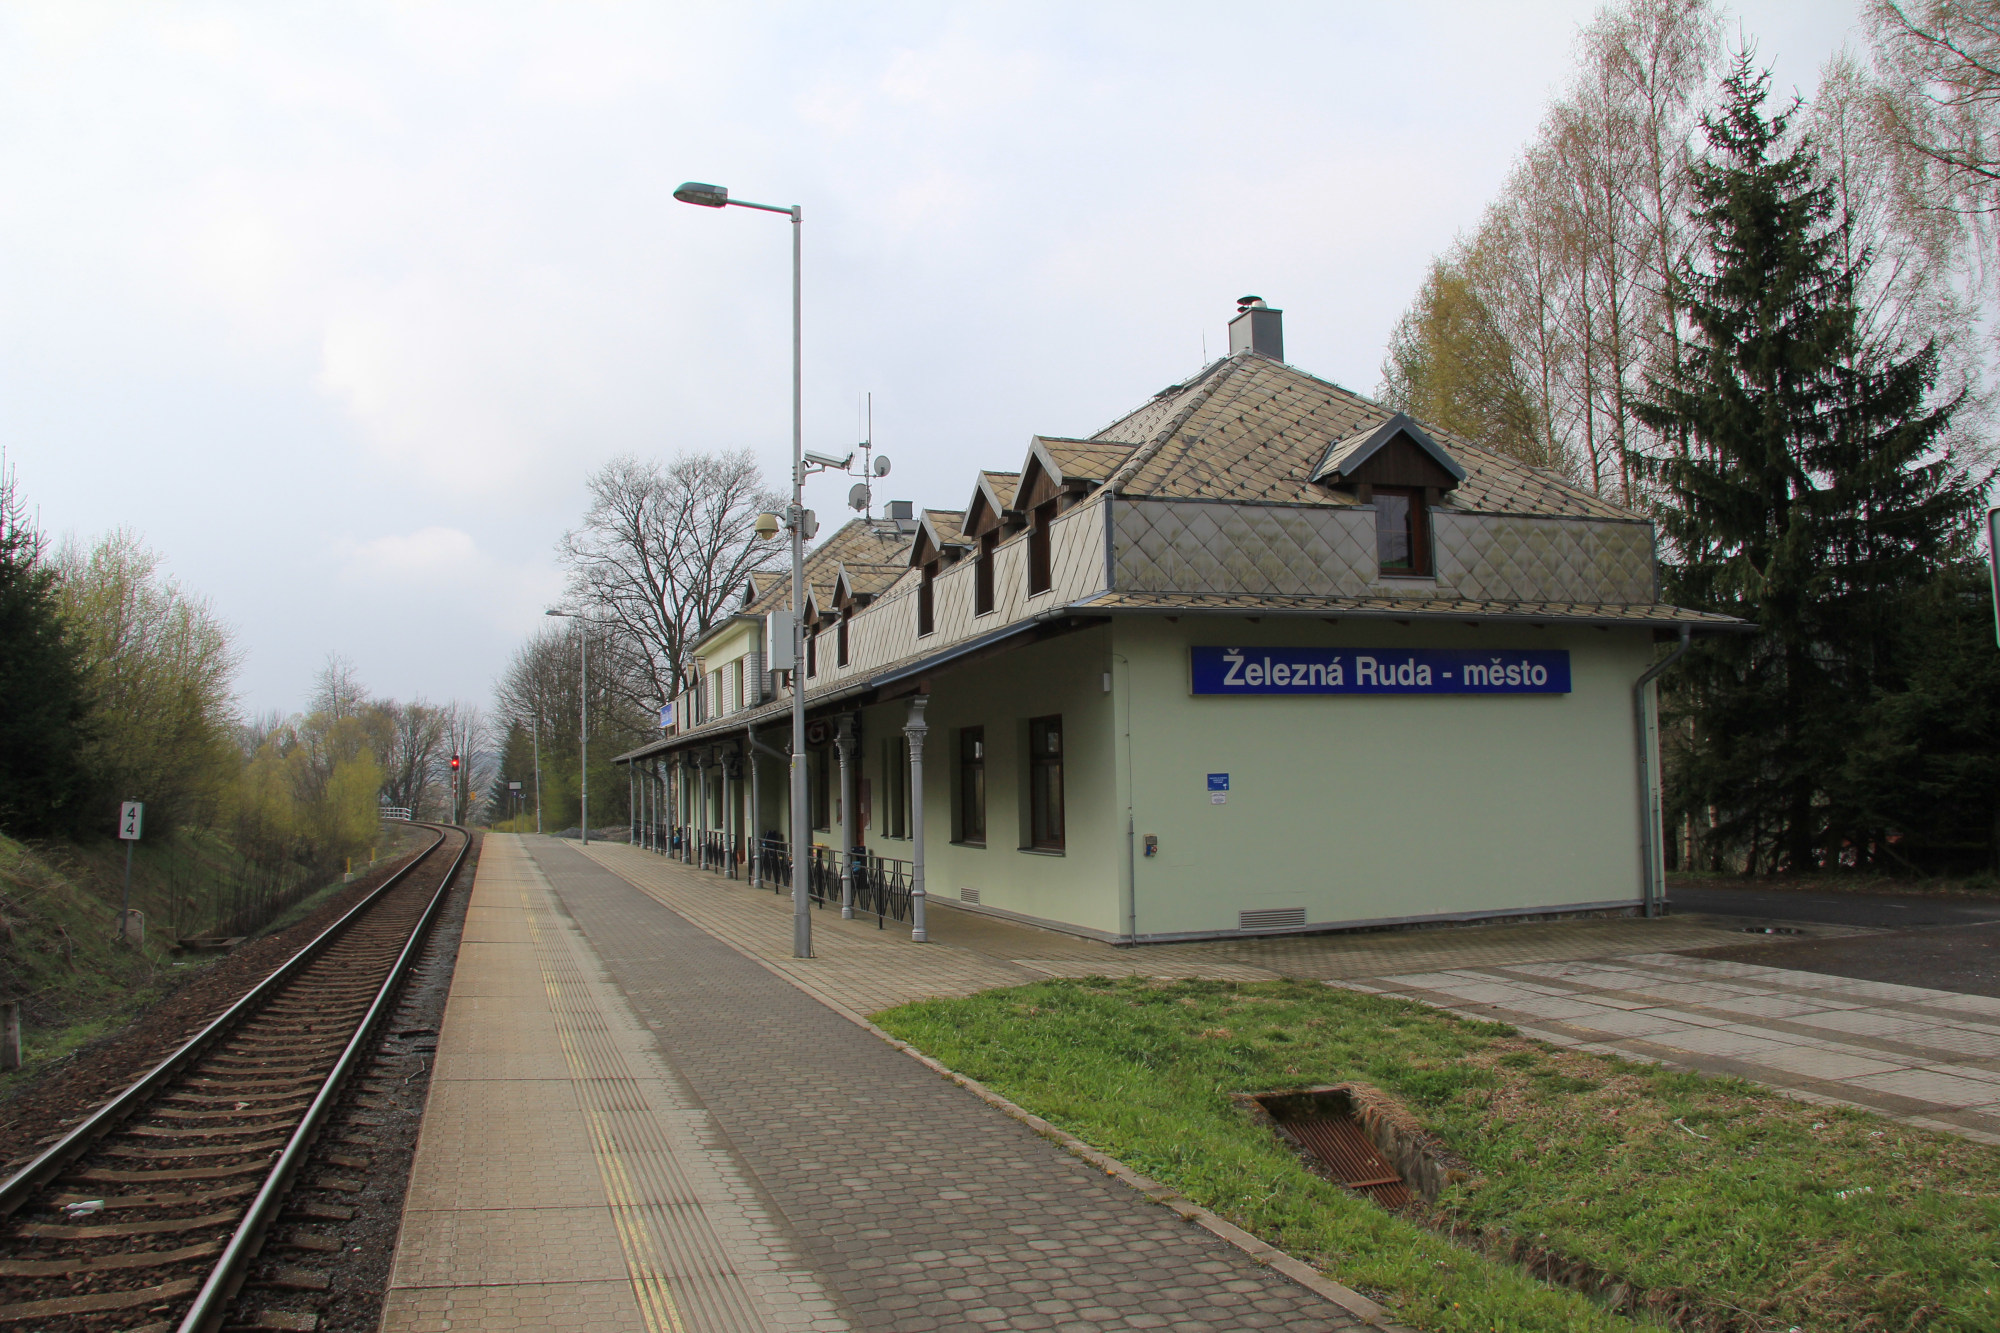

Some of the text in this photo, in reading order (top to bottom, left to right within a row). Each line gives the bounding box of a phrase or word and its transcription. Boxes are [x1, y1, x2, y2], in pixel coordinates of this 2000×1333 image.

[1223, 648, 1344, 687] Železná
[1356, 656, 1432, 687] Ruda
[1463, 658, 1547, 687] město
[127, 806, 136, 820] 4
[126, 822, 135, 836] 4
